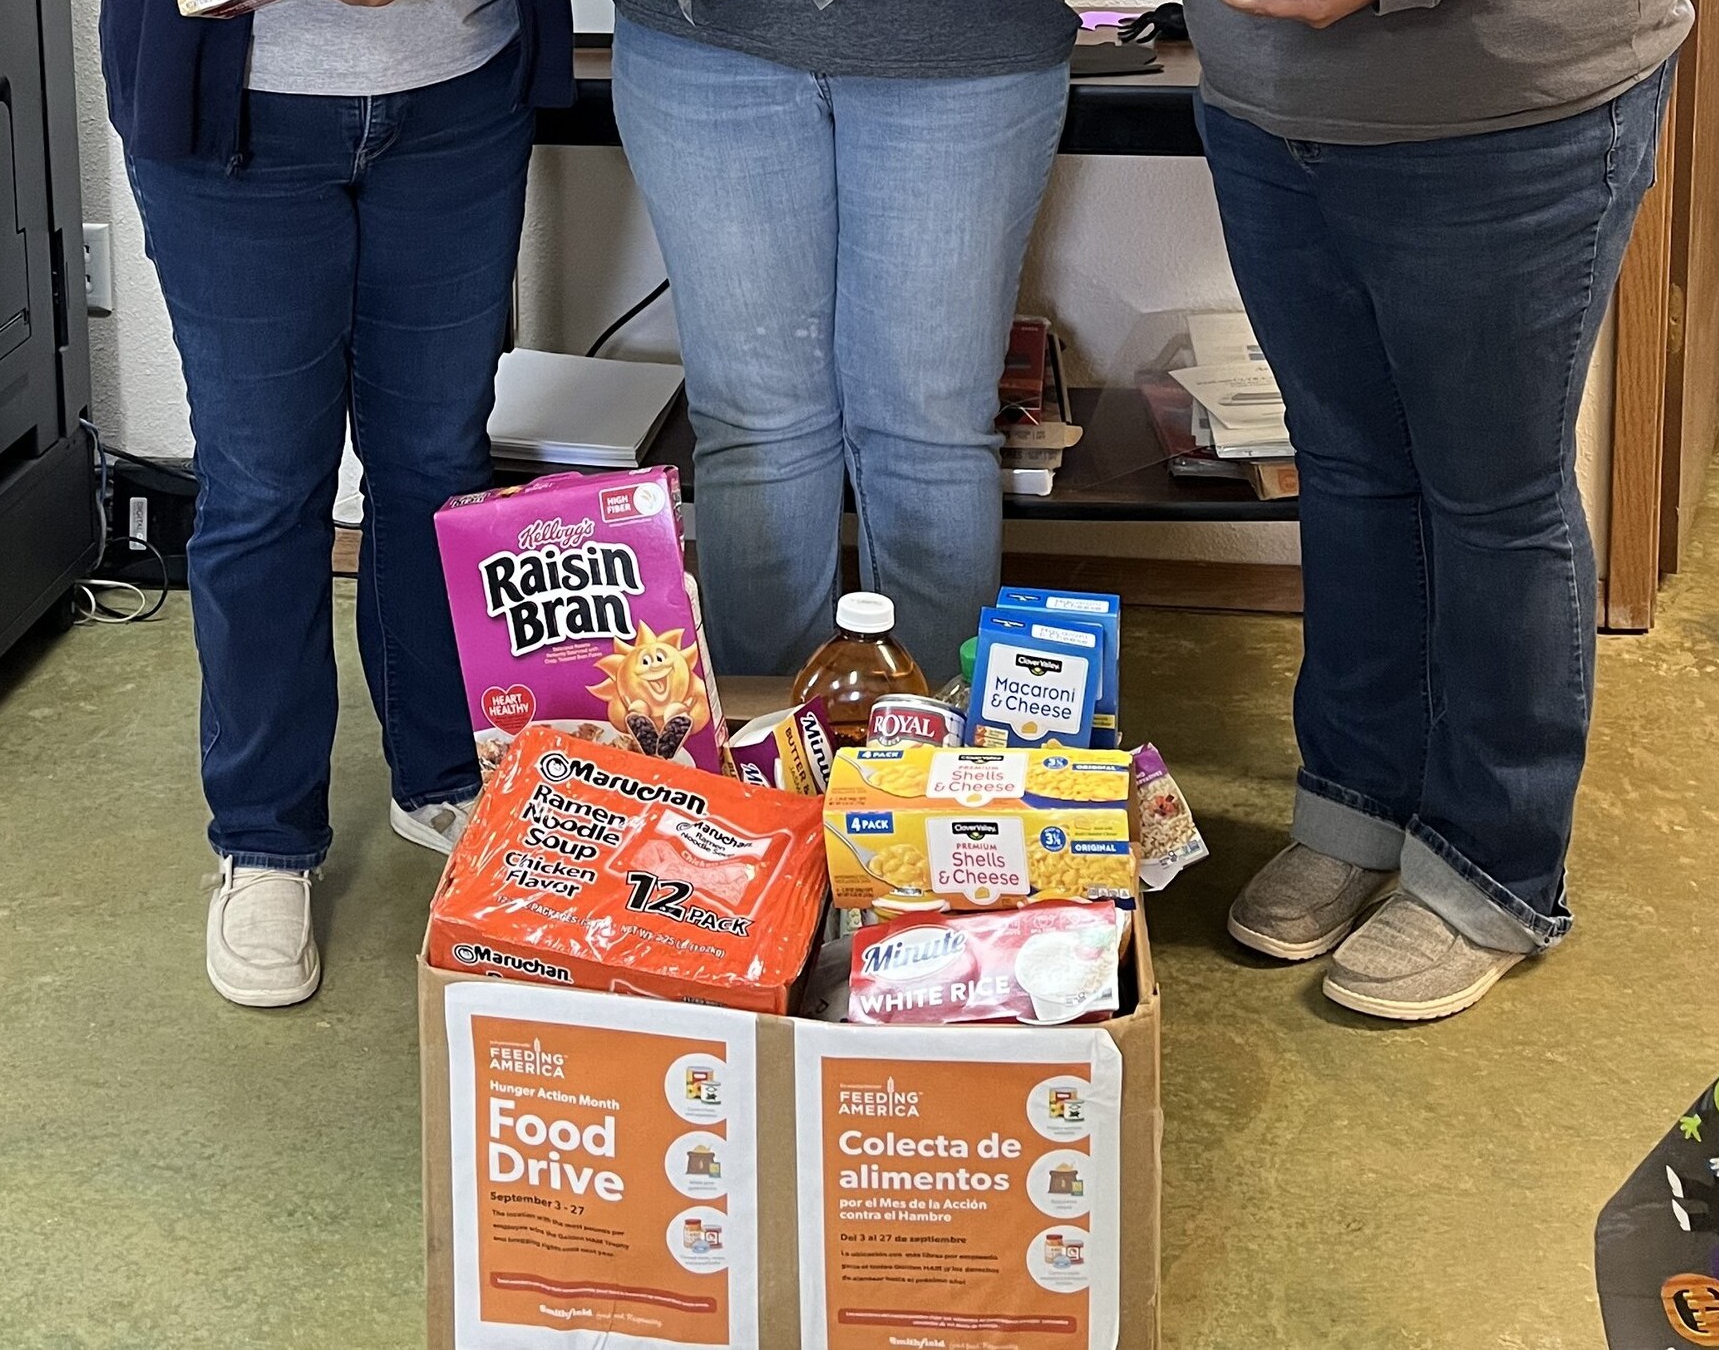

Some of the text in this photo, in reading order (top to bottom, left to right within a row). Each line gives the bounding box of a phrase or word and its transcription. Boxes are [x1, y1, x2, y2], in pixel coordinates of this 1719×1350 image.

[606, 494, 630, 505] HIGH
[606, 502, 632, 514] FIBER
[518, 518, 594, 549] Kellogg's
[484, 546, 640, 612] Raisin
[509, 594, 632, 651] Bran
[492, 693, 522, 706] HEART
[995, 676, 1076, 703] Macaroni
[489, 703, 529, 717] HEALTHY
[990, 693, 1072, 720] & Cheese
[873, 714, 936, 738] ROYAL
[785, 727, 807, 783] BUTTER
[801, 712, 832, 788] Minu
[862, 751, 872, 759] 4
[952, 770, 1004, 781] Shells
[569, 759, 708, 816] Maruchan
[934, 782, 1015, 792] & Cheese
[533, 784, 626, 829] Ramen
[522, 802, 621, 846] Noodle
[850, 817, 889, 832] 4 PACK
[524, 827, 598, 861] Soup
[681, 832, 711, 852] Noodle
[695, 832, 726, 851] Ramen
[956, 842, 998, 851] PREMIUM
[1075, 843, 1117, 852] ORIGINAL
[505, 851, 596, 882] Chicken
[952, 851, 1006, 868] Shells
[506, 869, 580, 897] Flavor
[938, 868, 1020, 886] & Cheese
[531, 902, 578, 924] PACKAGES
[627, 871, 755, 937] 12 PACK
[620, 924, 639, 935] NET
[864, 929, 967, 974] Minute
[474, 945, 572, 982] Maruchan
[860, 975, 1011, 1014] WHITE RICE
[490, 1046, 564, 1066] FEEDING
[490, 1058, 566, 1079] AMERICA
[490, 1080, 620, 1111] Hunger Action Month
[839, 1091, 920, 1105] FEEDING
[838, 1103, 920, 1118] AMERICA
[489, 1096, 616, 1158] Food
[838, 1130, 1022, 1159] Colecta de
[488, 1141, 625, 1202] Drive
[839, 1163, 1011, 1191] alimentos
[490, 1191, 553, 1208] September
[554, 1200, 561, 1211] 3
[570, 1204, 585, 1216] 27
[492, 1209, 505, 1217] The
[839, 1197, 987, 1210] por el Mes de la Acción
[839, 1210, 952, 1222] contra el Hambre
[840, 1233, 857, 1242] Del
[860, 1234, 866, 1242] 3
[879, 1234, 892, 1242] 27
[894, 1235, 908, 1243] de
[909, 1235, 967, 1244] septiembre
[539, 1304, 593, 1320] Smithfield
[888, 1336, 946, 1350] Smithfield
